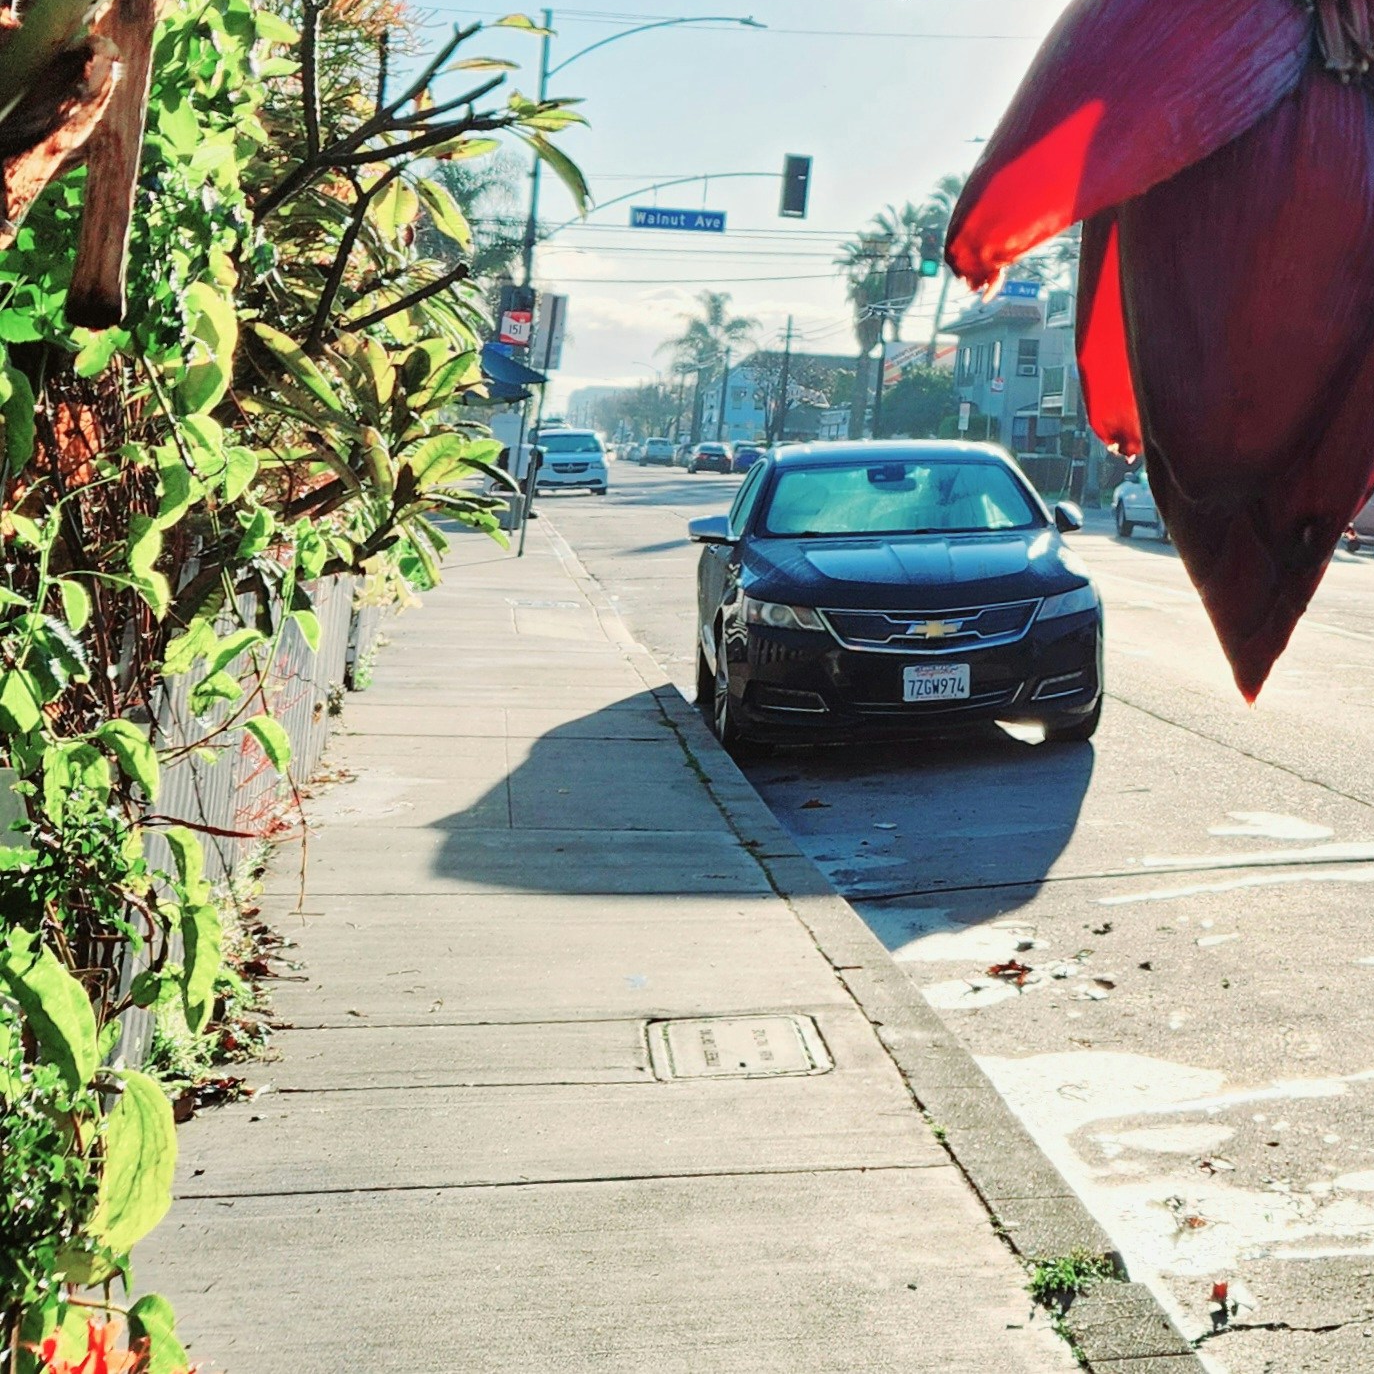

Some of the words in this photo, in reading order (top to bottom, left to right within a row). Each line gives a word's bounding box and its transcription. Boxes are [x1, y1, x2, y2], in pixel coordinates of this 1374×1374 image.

[636, 212, 686, 226] Walnut
[694, 214, 721, 228] Ave
[509, 324, 522, 335] 151
[908, 677, 964, 696] 7ZGW974
